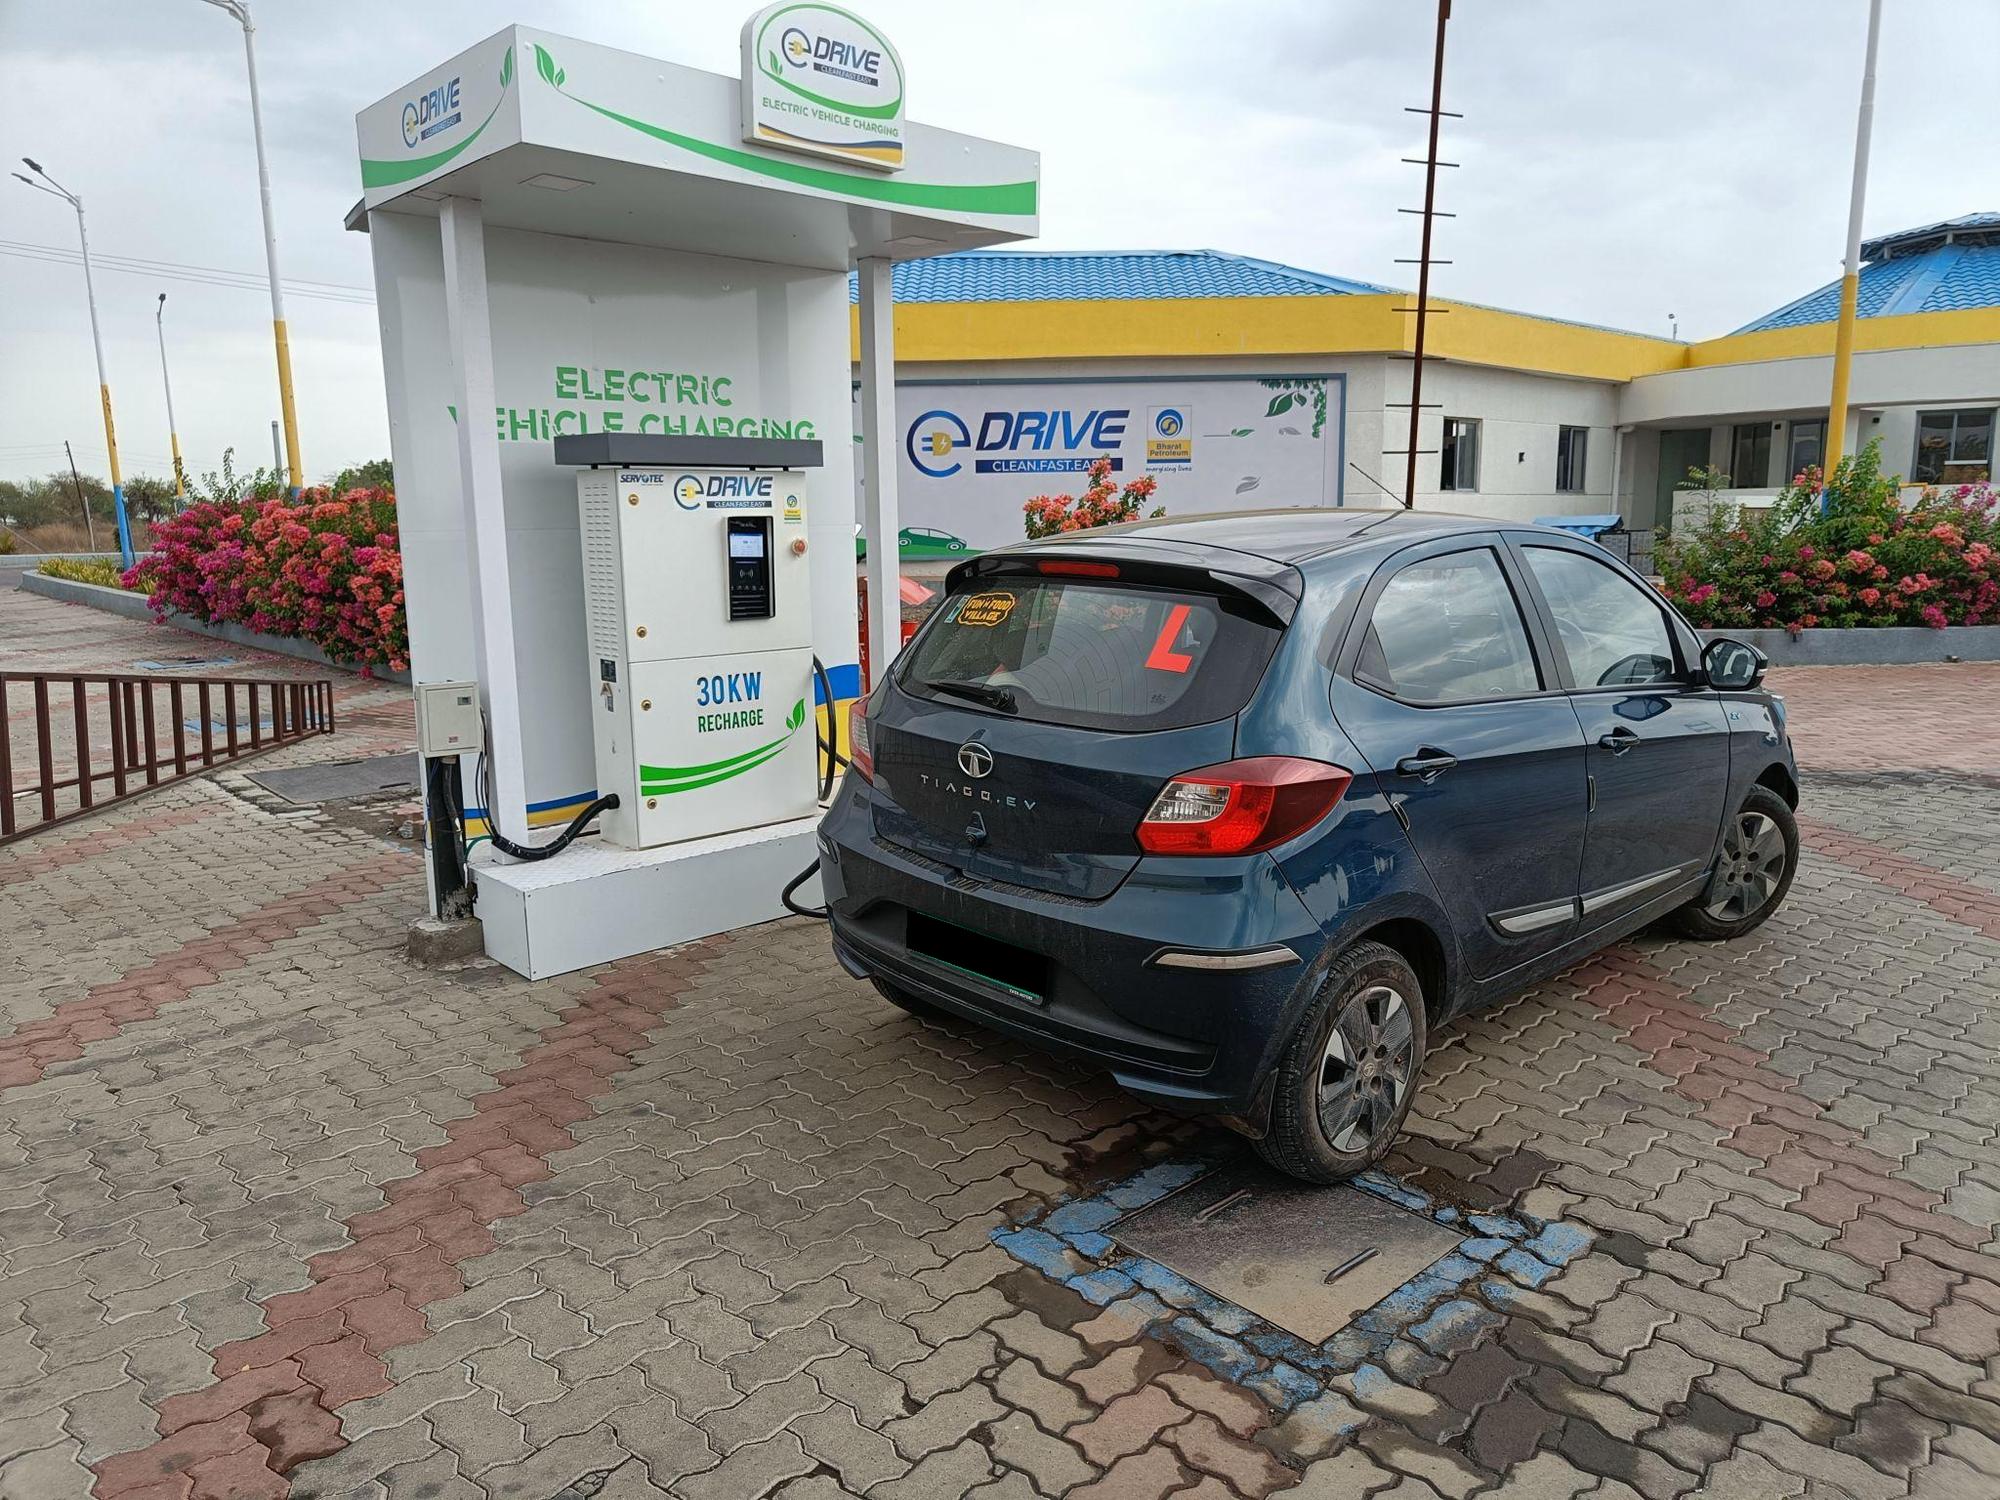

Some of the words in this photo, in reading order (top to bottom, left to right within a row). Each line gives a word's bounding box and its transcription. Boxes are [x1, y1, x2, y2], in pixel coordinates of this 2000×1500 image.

[813, 36, 881, 74] DRIVE
[420, 76, 460, 126] DRIVE
[762, 97, 809, 117] ELECTRIC
[811, 109, 851, 127] VEHICLE
[853, 119, 899, 138] CHARGING
[556, 366, 733, 407] ELECTRIC
[447, 405, 624, 441] HICLE
[975, 409, 1130, 451] DRIVE
[620, 474, 664, 483] SERVOTEC
[992, 458, 1100, 473] CLEAN.FAST.EA
[706, 476, 774, 497] DRIVE
[964, 610, 1002, 621] VILLAGE
[988, 599, 1012, 611] FOOD
[1145, 604, 1192, 673] L
[697, 672, 761, 706] 30KW
[698, 709, 764, 733] RECHARGE
[1338, 974, 1368, 1011] apollo
[1371, 1123, 1399, 1160] apollo
